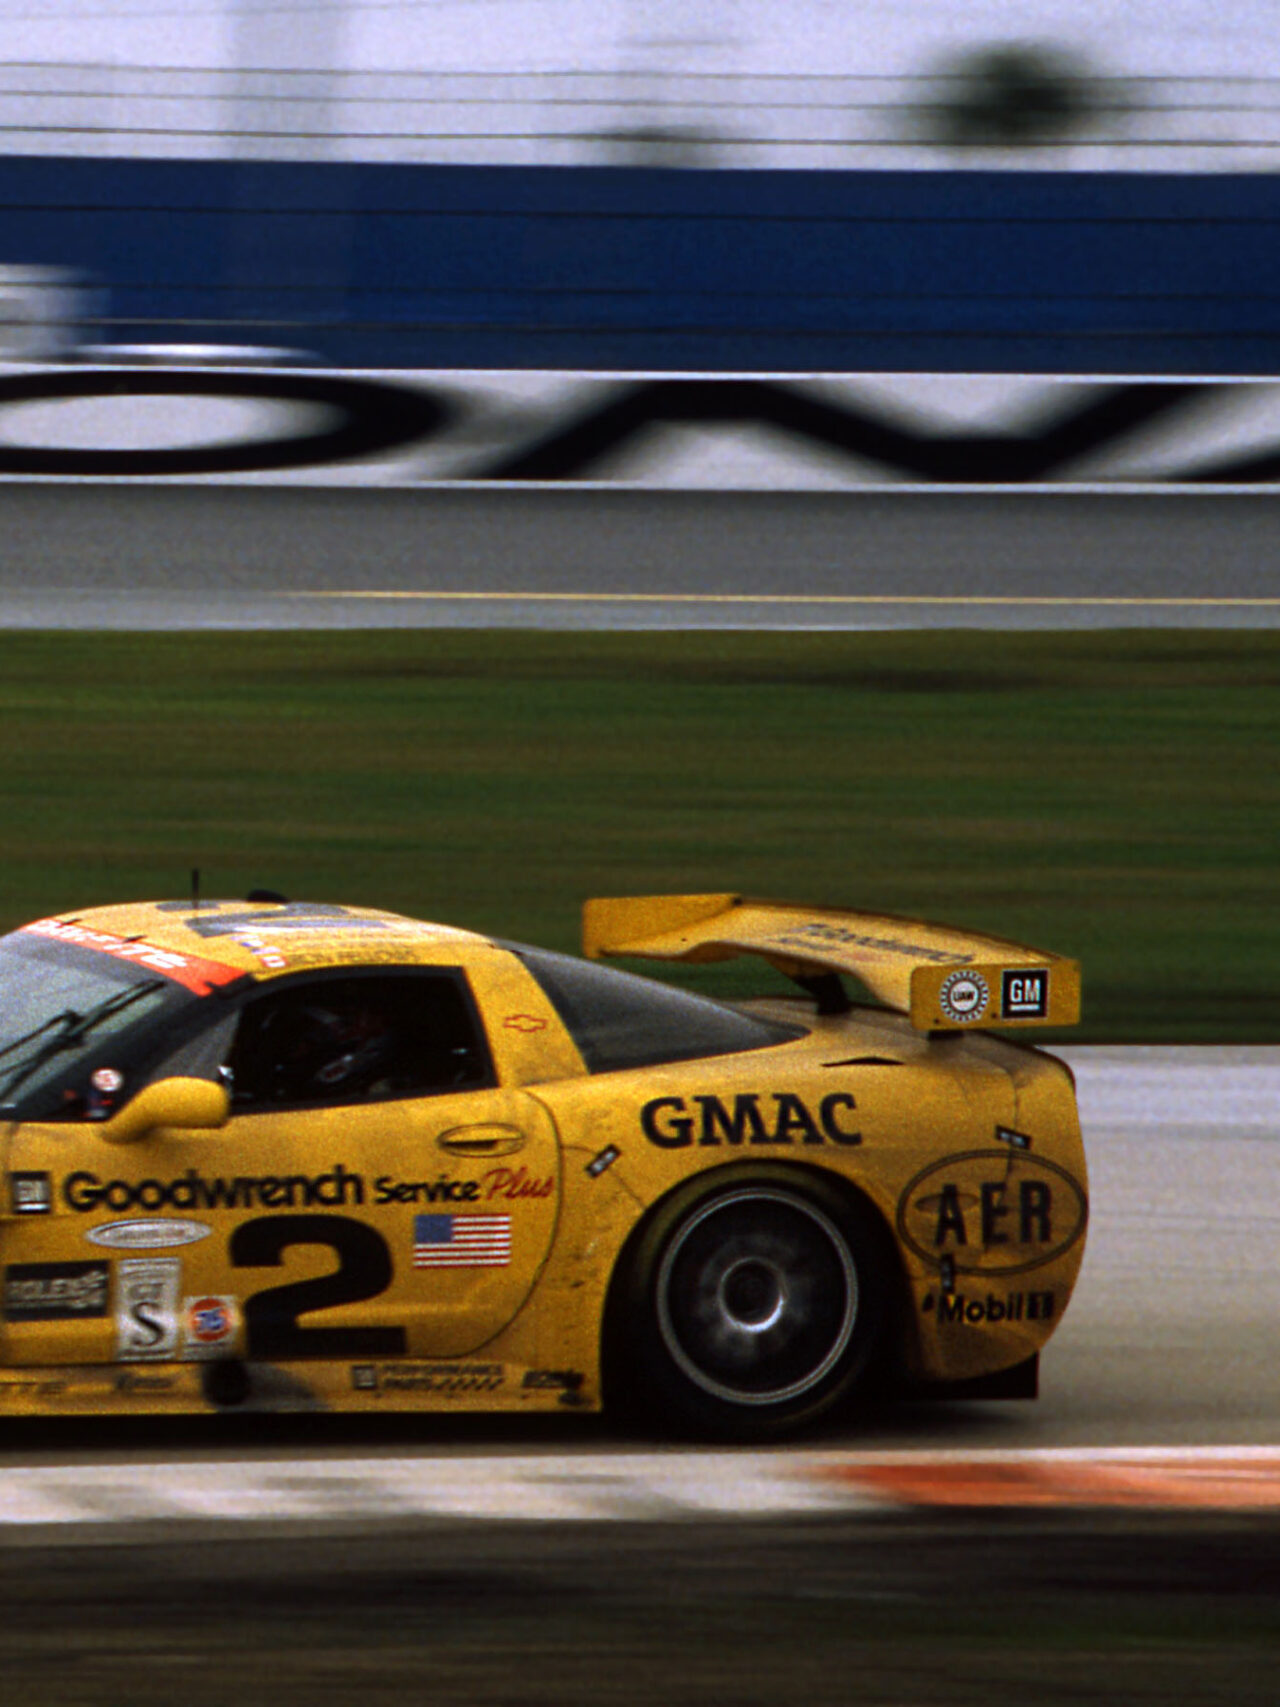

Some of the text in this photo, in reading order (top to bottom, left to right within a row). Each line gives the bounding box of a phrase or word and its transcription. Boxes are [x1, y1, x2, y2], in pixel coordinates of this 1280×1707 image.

[1009, 979, 1041, 1003] GM
[640, 1093, 863, 1149] GMAC
[65, 1165, 554, 1212] Goodwrench Service Plus
[935, 1180, 1052, 1246] AER
[229, 1214, 407, 1355] 2
[939, 1292, 1022, 1324] Mobil
[130, 1301, 165, 1347] S
